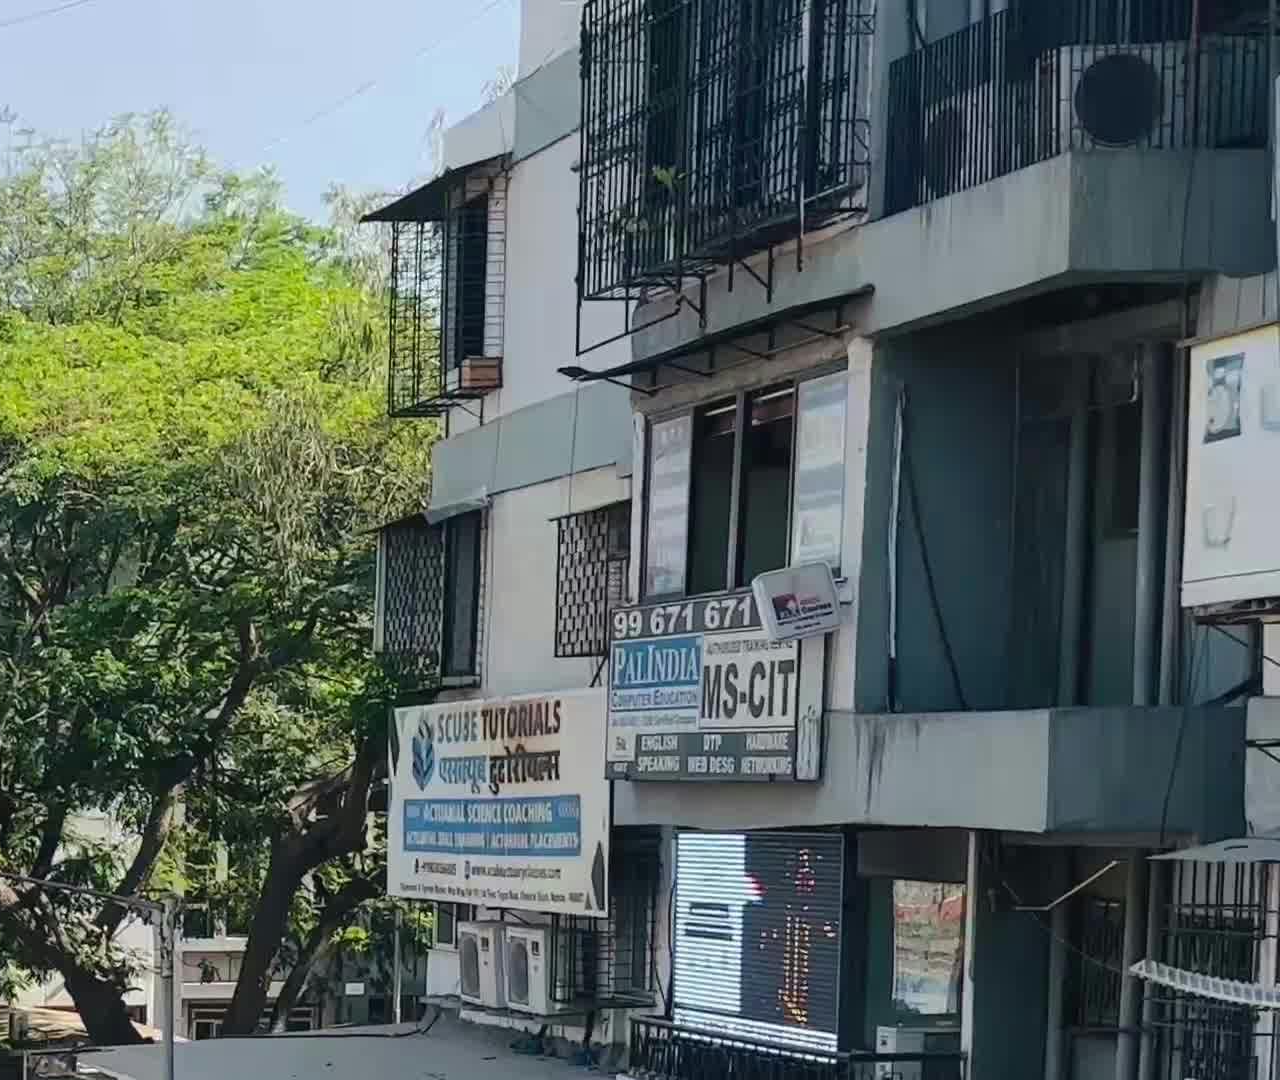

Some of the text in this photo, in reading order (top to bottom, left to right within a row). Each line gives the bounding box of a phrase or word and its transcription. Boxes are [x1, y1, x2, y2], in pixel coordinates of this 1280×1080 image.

[613, 610, 642, 639] 99
[649, 604, 694, 632] 671
[703, 597, 753, 629] 671
[701, 659, 796, 720] MS-CIT
[438, 700, 562, 744] SCUBE TUTORIALS
[639, 734, 679, 752] ENGLISH
[702, 734, 723, 752] DTP
[637, 755, 681, 773] SPEAKING
[503, 802, 553, 824] COACHING
